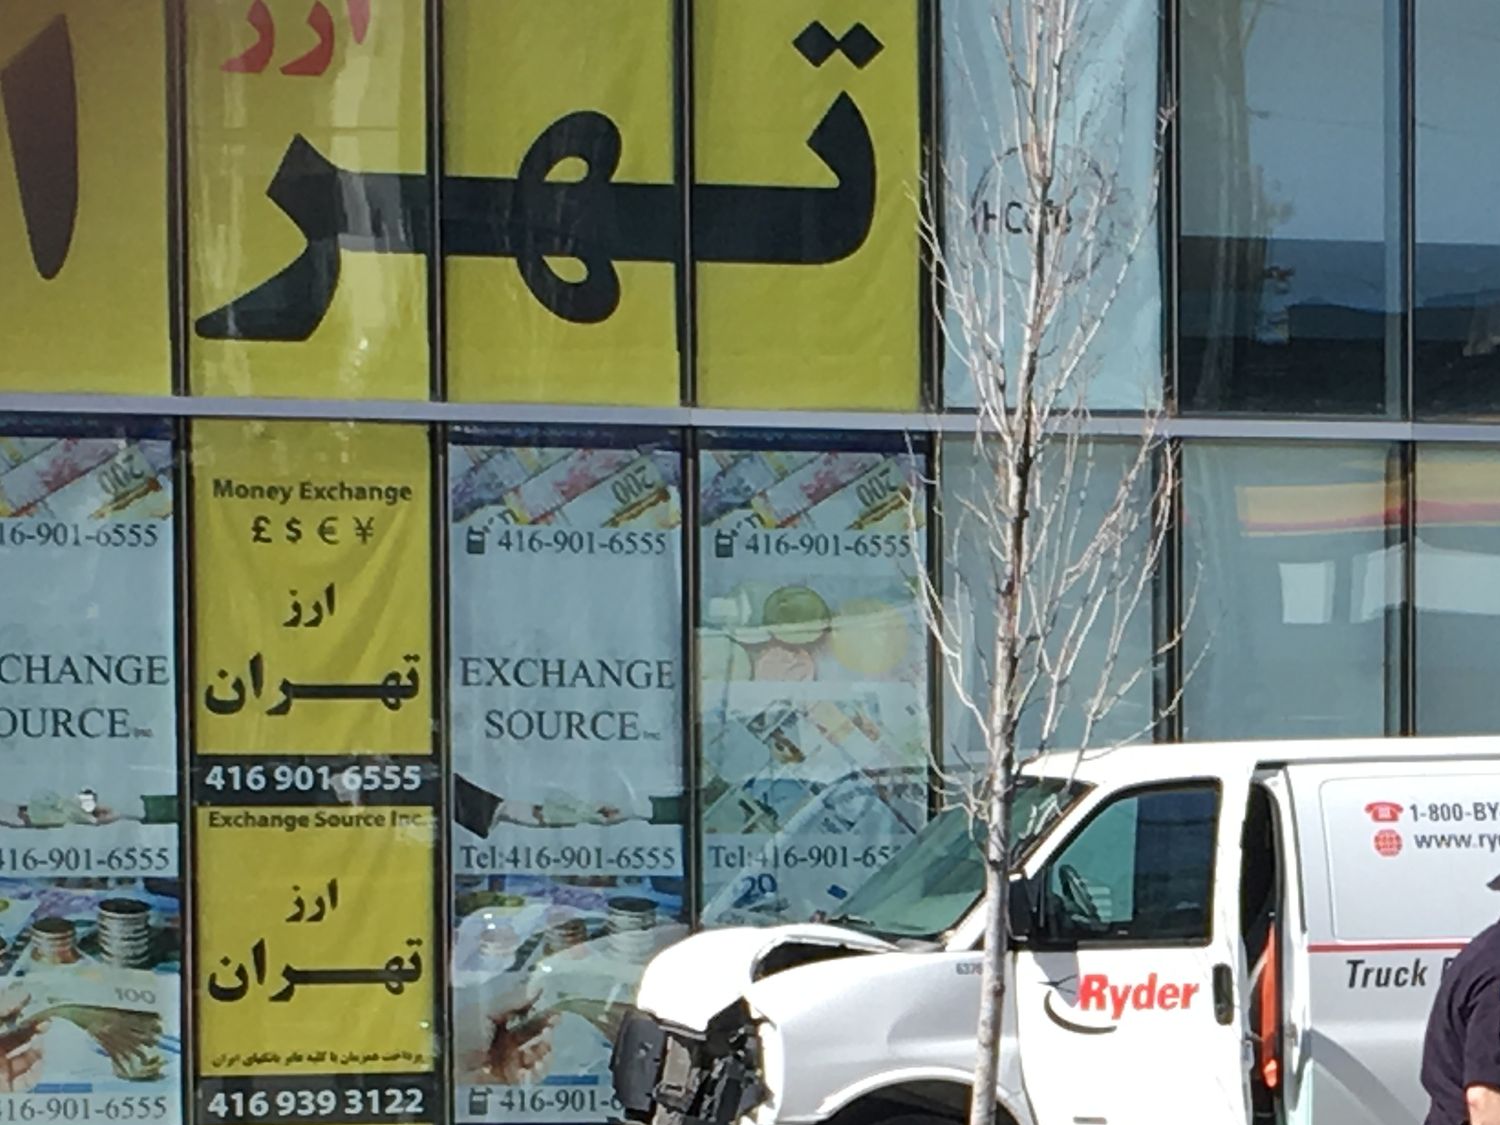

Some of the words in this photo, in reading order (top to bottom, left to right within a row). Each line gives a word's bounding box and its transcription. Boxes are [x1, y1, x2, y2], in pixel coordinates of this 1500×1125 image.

[212, 479, 293, 505] Money
[299, 481, 413, 506] Exchange
[286, 517, 302, 544] $
[318, 516, 339, 545] €
[353, 517, 375, 544] ¥
[498, 529, 667, 555] 416-901-6555
[746, 533, 911, 559] 416-901-6555
[282, 582, 336, 628] ارز
[460, 656, 676, 690] EXCHANGE
[484, 709, 640, 741] SOURCE
[205, 765, 267, 791] 416
[273, 765, 331, 791] 901
[341, 765, 422, 791] 6555
[208, 811, 310, 833] Exchange
[314, 811, 386, 829] Source
[459, 845, 676, 870] Tel:416-901-6555
[285, 879, 338, 922] ارز
[1346, 958, 1427, 989] Truck
[1079, 973, 1200, 1020] Ryder
[0, 1096, 167, 1121] 16-901-6555
[207, 1092, 270, 1118] 416
[276, 1090, 337, 1117] 939
[344, 1088, 424, 1115] 3122
